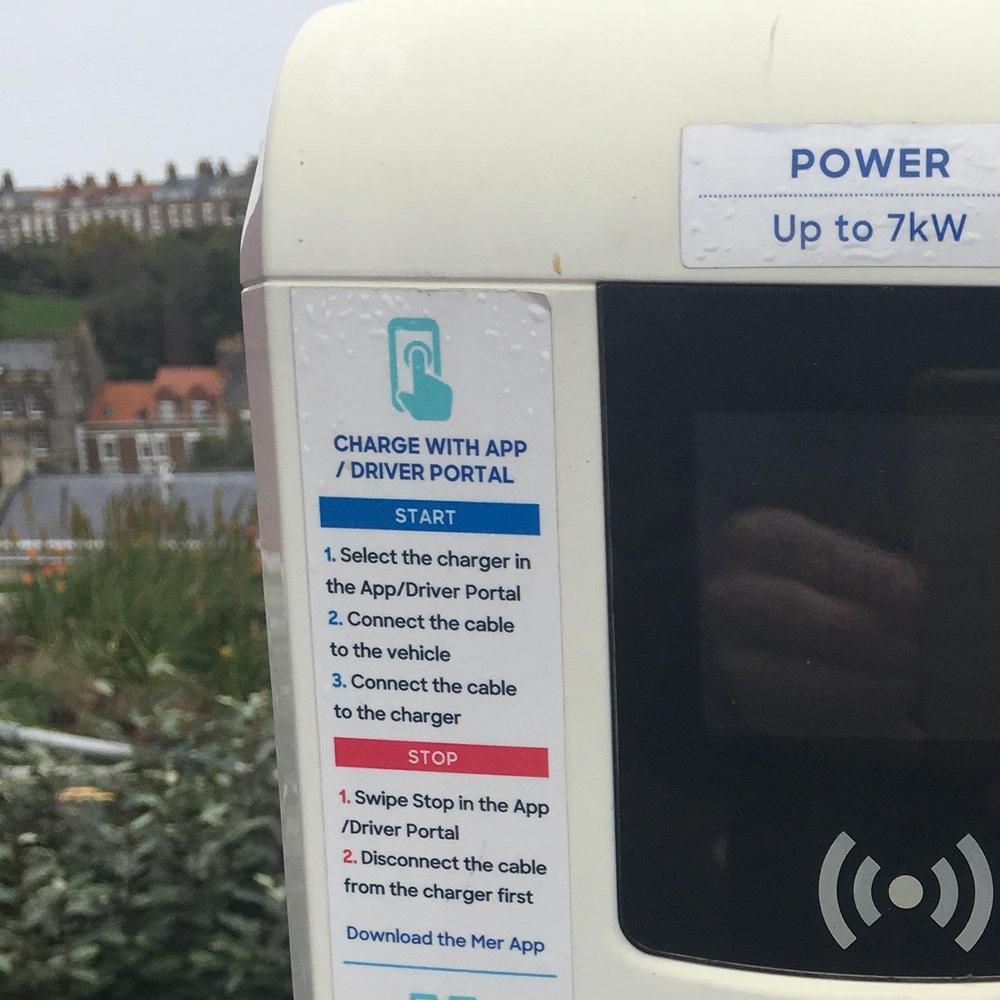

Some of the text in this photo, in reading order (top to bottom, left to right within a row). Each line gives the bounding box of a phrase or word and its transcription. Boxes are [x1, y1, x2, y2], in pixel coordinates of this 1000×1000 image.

[791, 148, 950, 179] POWER
[774, 212, 967, 250] Up to 7kW
[334, 435, 527, 457] CHARGE WITH APP
[336, 461, 514, 484] / DRIVER PORTAL
[395, 508, 456, 525] START
[324, 547, 531, 572] 1. Select the charger in
[325, 578, 521, 601] the App/Driver Portal
[330, 642, 451, 662] to the vehicle
[333, 704, 461, 728] to the charger
[408, 749, 458, 765] STOP
[341, 819, 459, 840] /Driver Portal
[347, 926, 545, 956] Download the Mer App
